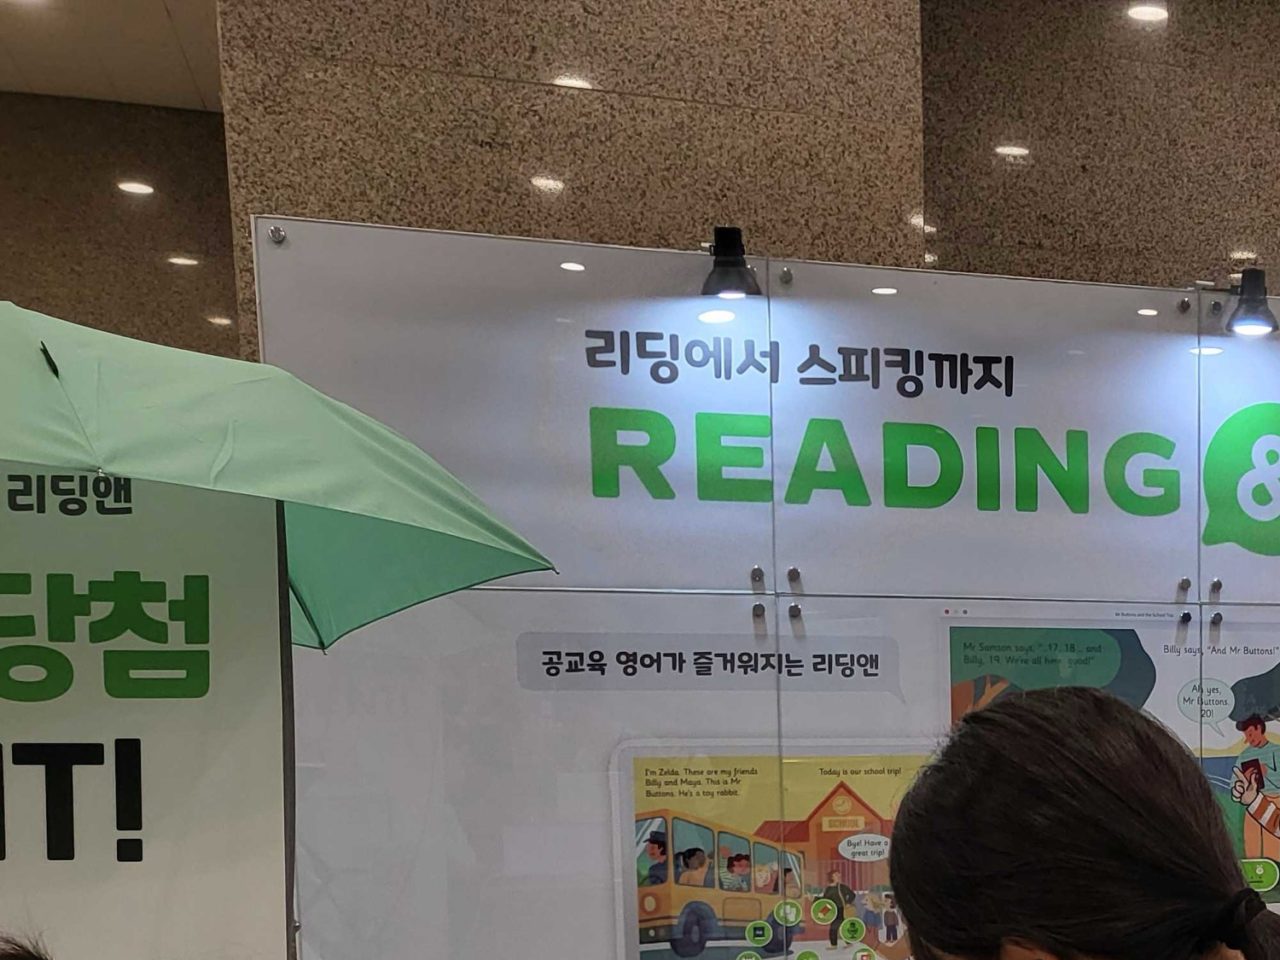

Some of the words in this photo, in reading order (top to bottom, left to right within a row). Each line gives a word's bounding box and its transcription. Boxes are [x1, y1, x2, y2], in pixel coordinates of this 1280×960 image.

[585, 330, 779, 384] 리딩에서
[797, 344, 1013, 397] 스피킹까지
[7, 474, 133, 516] 리딩앤
[1164, 645, 1181, 656] Billy
[1230, 647, 1240, 655] Mr
[542, 650, 607, 676] 공교육
[616, 651, 686, 677] 영어가
[693, 651, 804, 678] 즐거워지는
[812, 653, 879, 678] 리딩앤
[1183, 696, 1195, 705] Mr
[1207, 686, 1222, 696] yes,
[864, 767, 885, 775] school
[0, 738, 143, 862] T!
